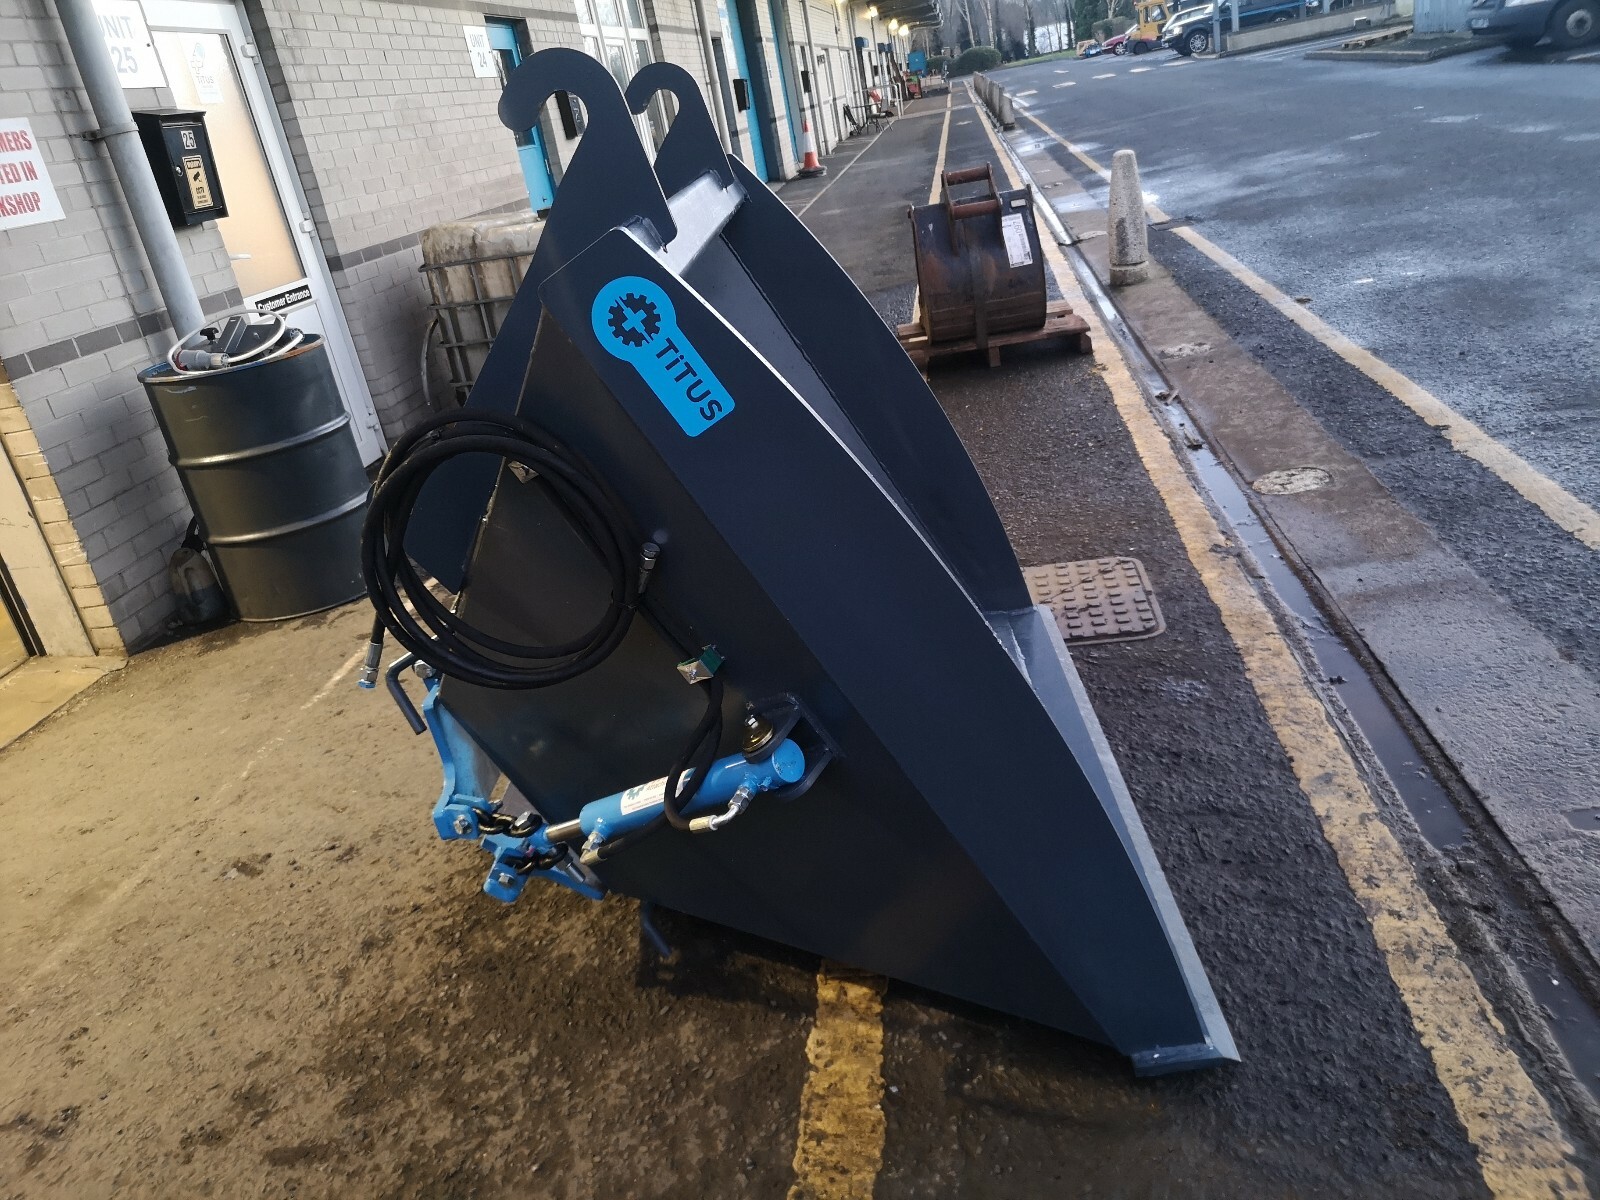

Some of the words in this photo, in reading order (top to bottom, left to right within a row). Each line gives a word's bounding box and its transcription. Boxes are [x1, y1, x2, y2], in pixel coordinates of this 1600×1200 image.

[469, 33, 485, 48] UNIT
[110, 45, 139, 74] 25
[477, 51, 488, 68] 24
[182, 131, 196, 148] 25
[19, 160, 39, 181] IN
[257, 297, 286, 311] Customer
[284, 289, 311, 304] Entrance
[656, 337, 723, 421] TiTUS
